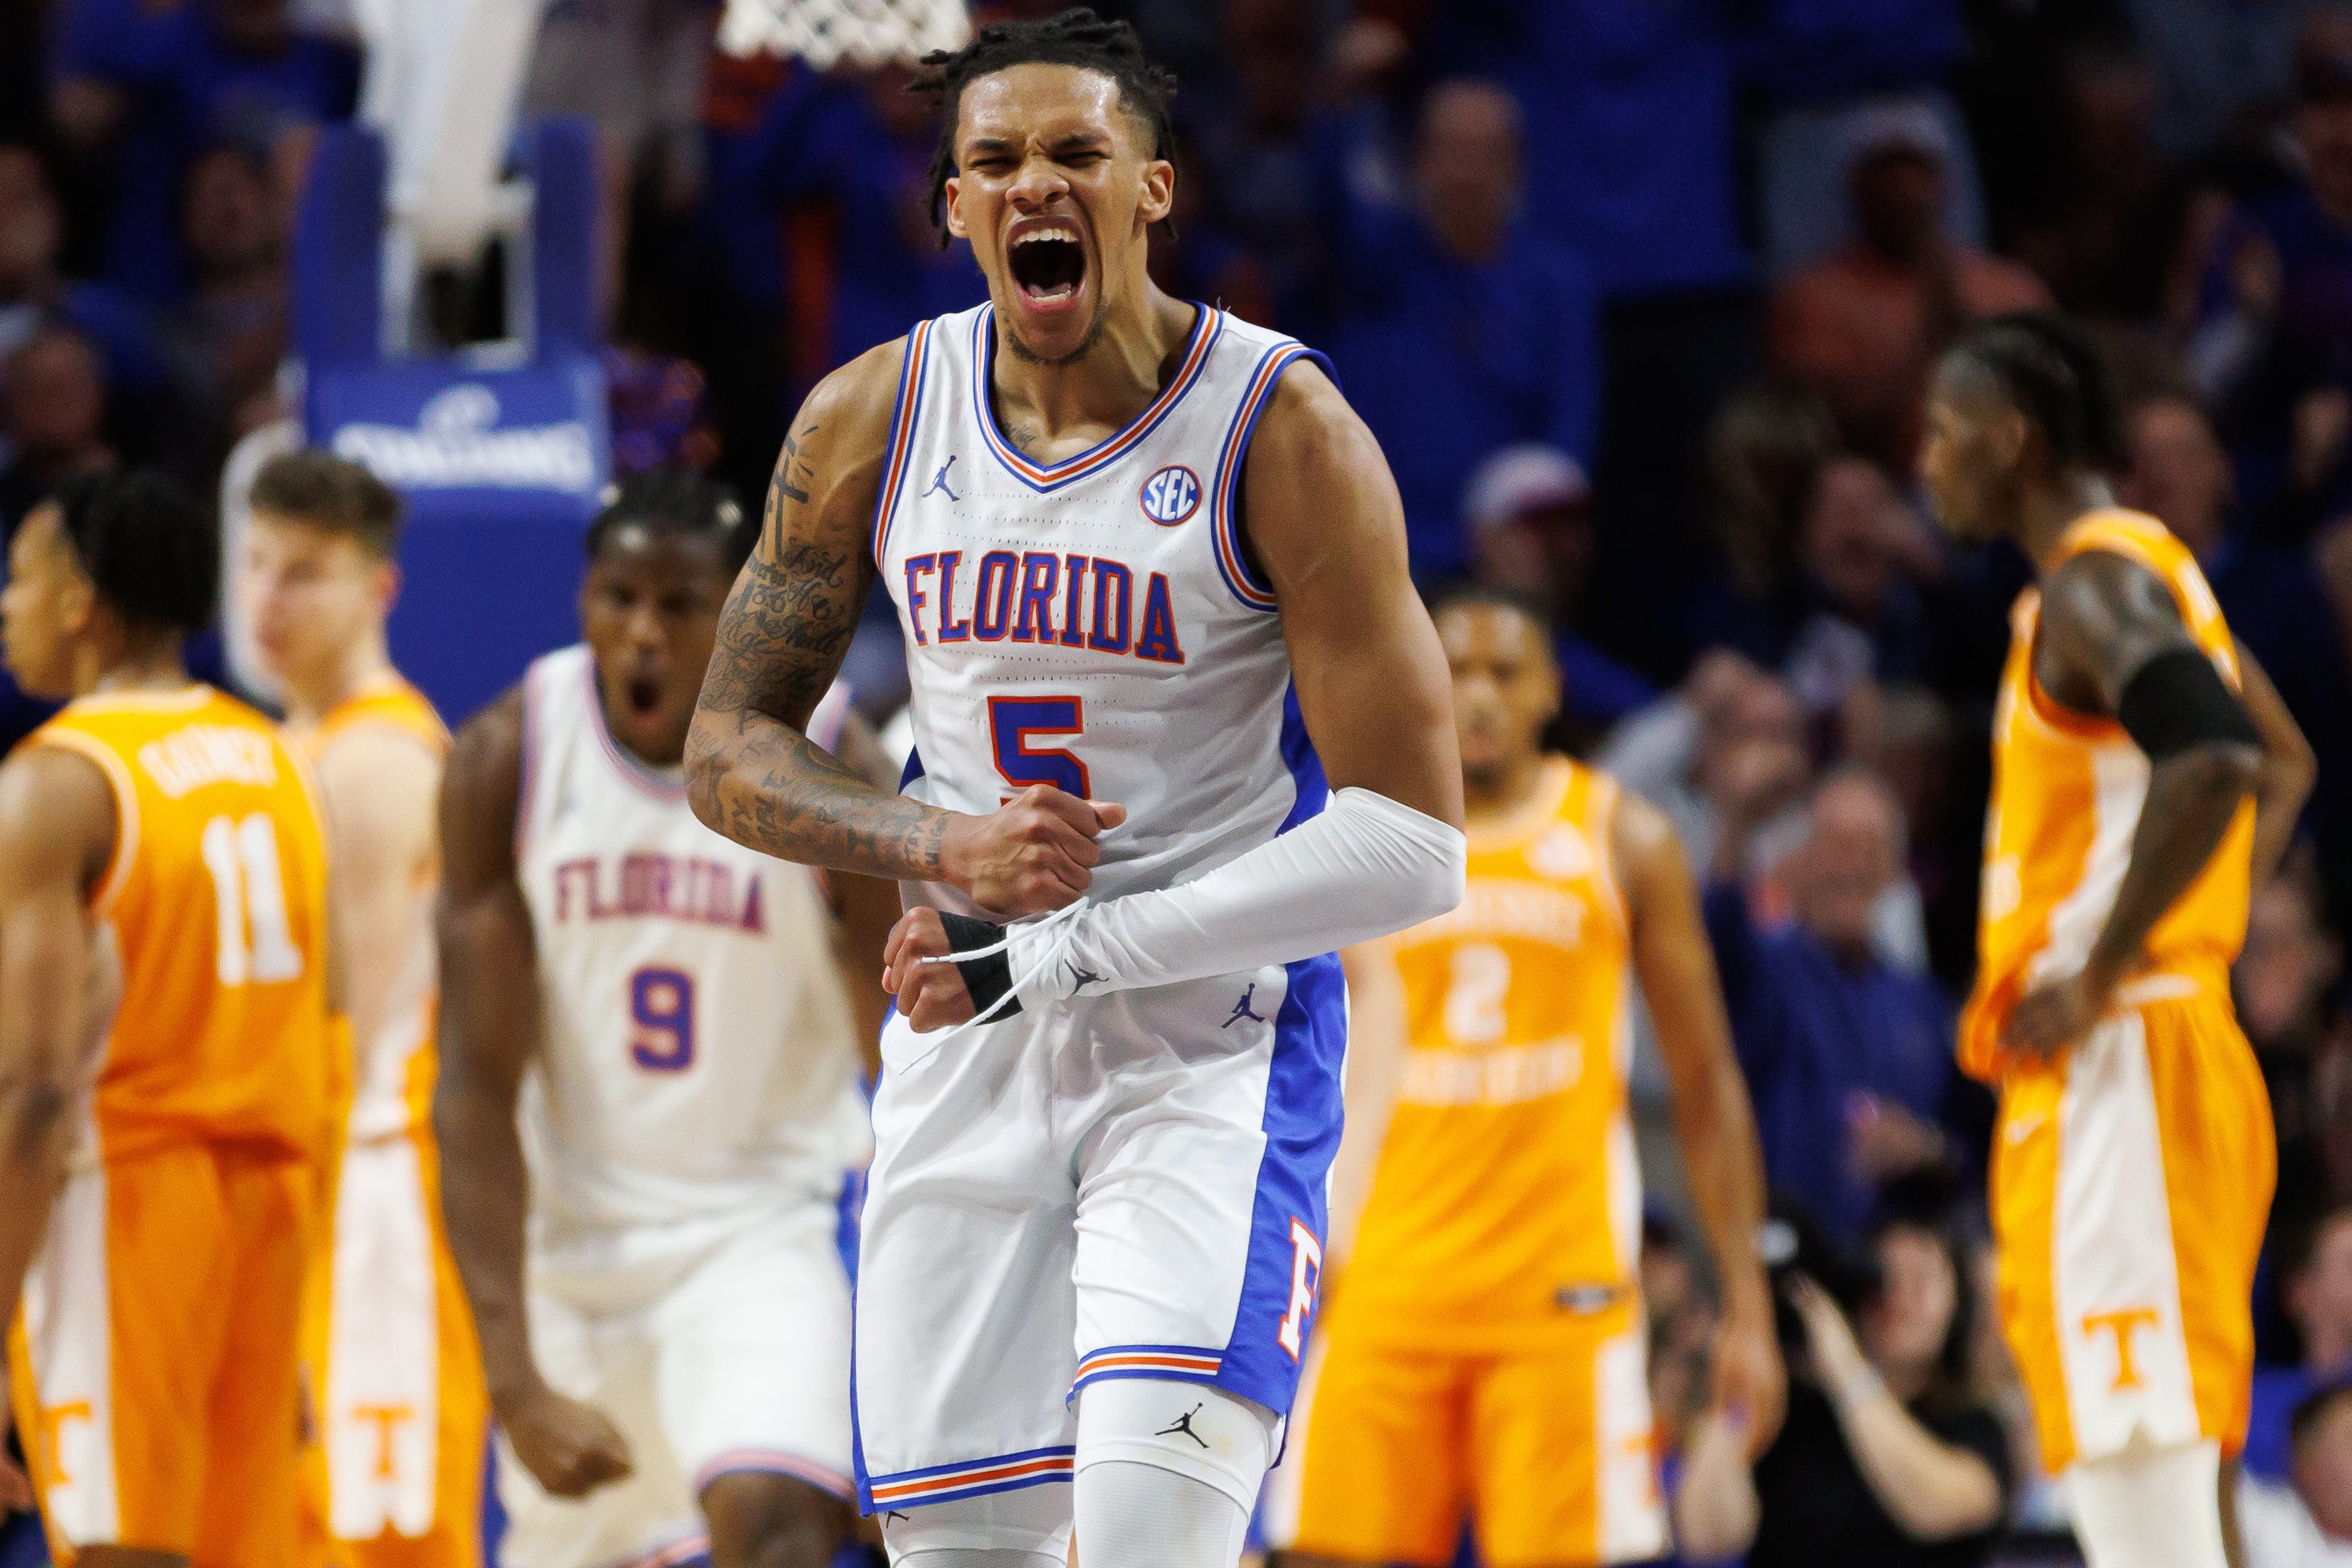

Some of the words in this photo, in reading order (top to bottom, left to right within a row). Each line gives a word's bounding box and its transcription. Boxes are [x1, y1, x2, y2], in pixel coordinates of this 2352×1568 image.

[1145, 469, 1196, 520] SEC
[905, 551, 1185, 664] FLORIDA
[987, 695, 1091, 807] 5
[201, 813, 305, 988] 11
[553, 851, 772, 937] FLORIDA
[629, 967, 695, 1073] 9
[1444, 942, 1511, 1042] 2
[2081, 1307, 2159, 1393] T
[352, 1405, 414, 1482] T
